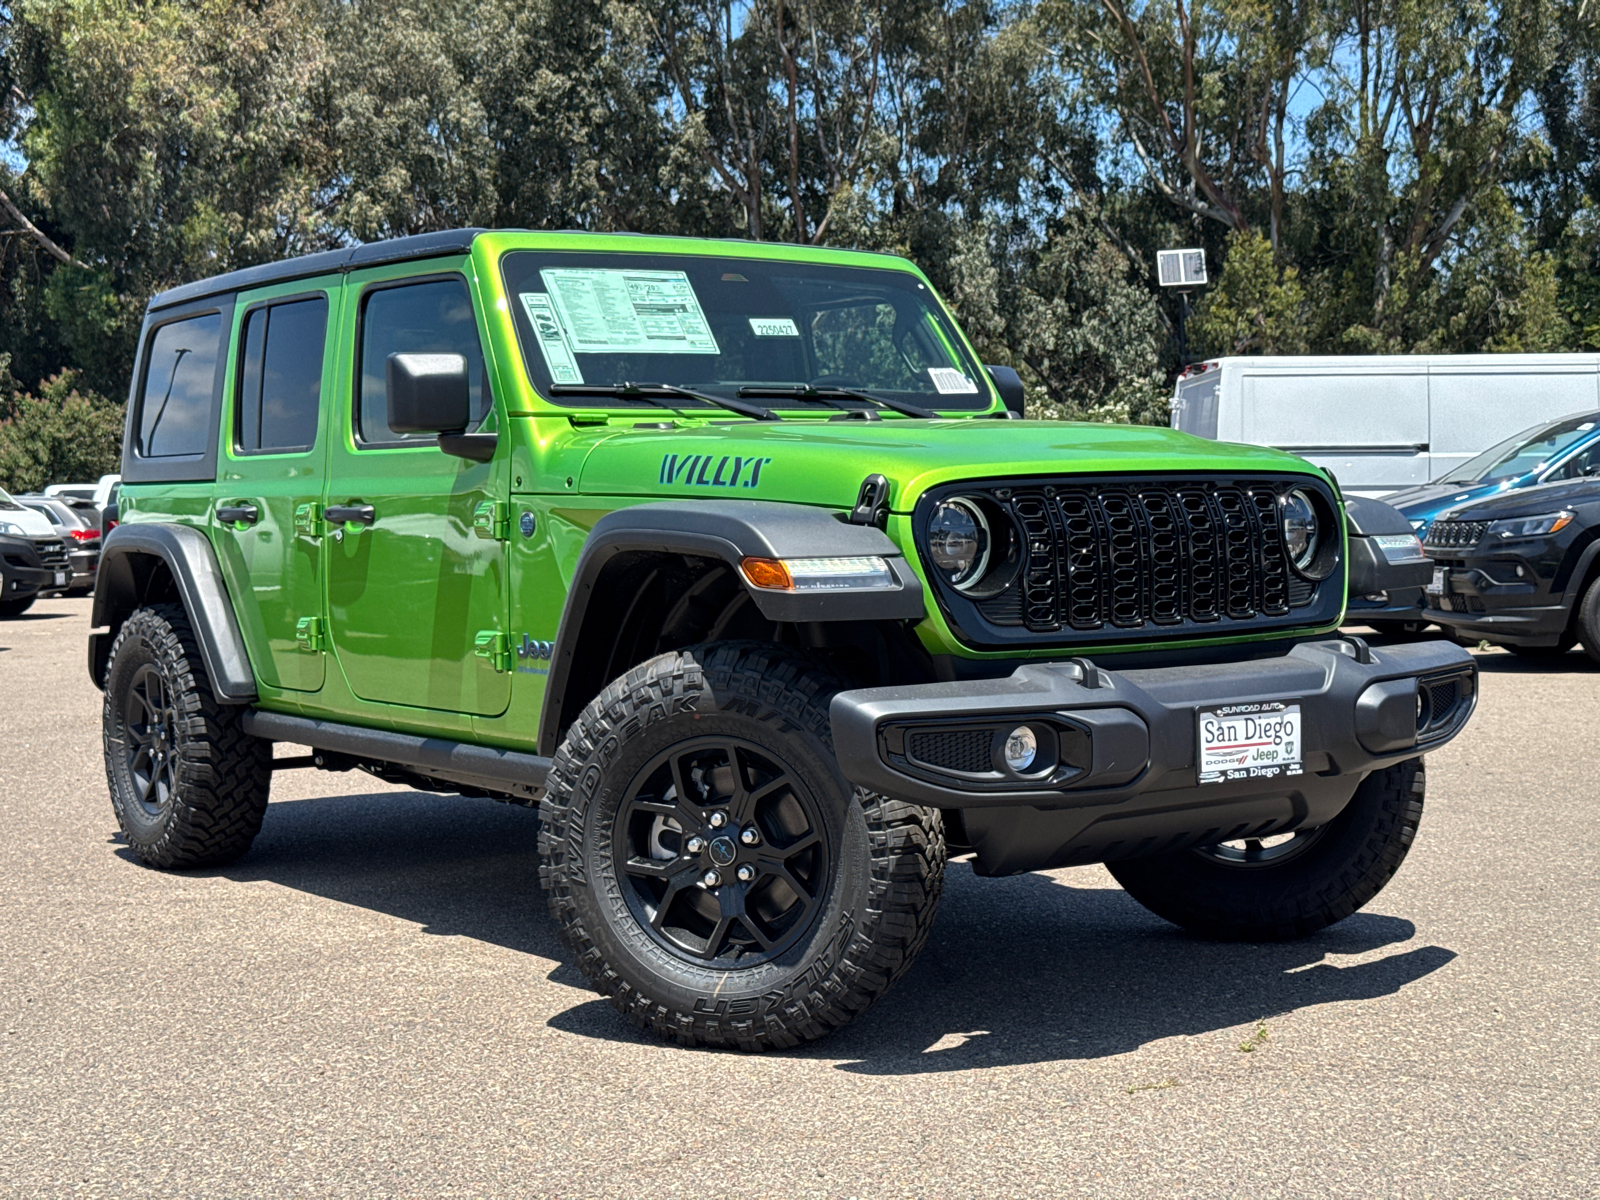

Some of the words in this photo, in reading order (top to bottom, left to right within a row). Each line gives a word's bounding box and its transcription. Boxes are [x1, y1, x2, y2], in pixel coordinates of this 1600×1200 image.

[757, 325, 794, 335] 2250427
[659, 453, 772, 489] WILLYS
[1221, 704, 1260, 714] SUNROAD
[1261, 702, 1280, 710] AUTO
[1204, 720, 1239, 743] San
[1243, 715, 1294, 746] Diego
[1252, 748, 1279, 762] Jeep
[1227, 770, 1247, 779] San
[1250, 766, 1280, 777] Diego
[569, 694, 698, 885] WILDPEAK
